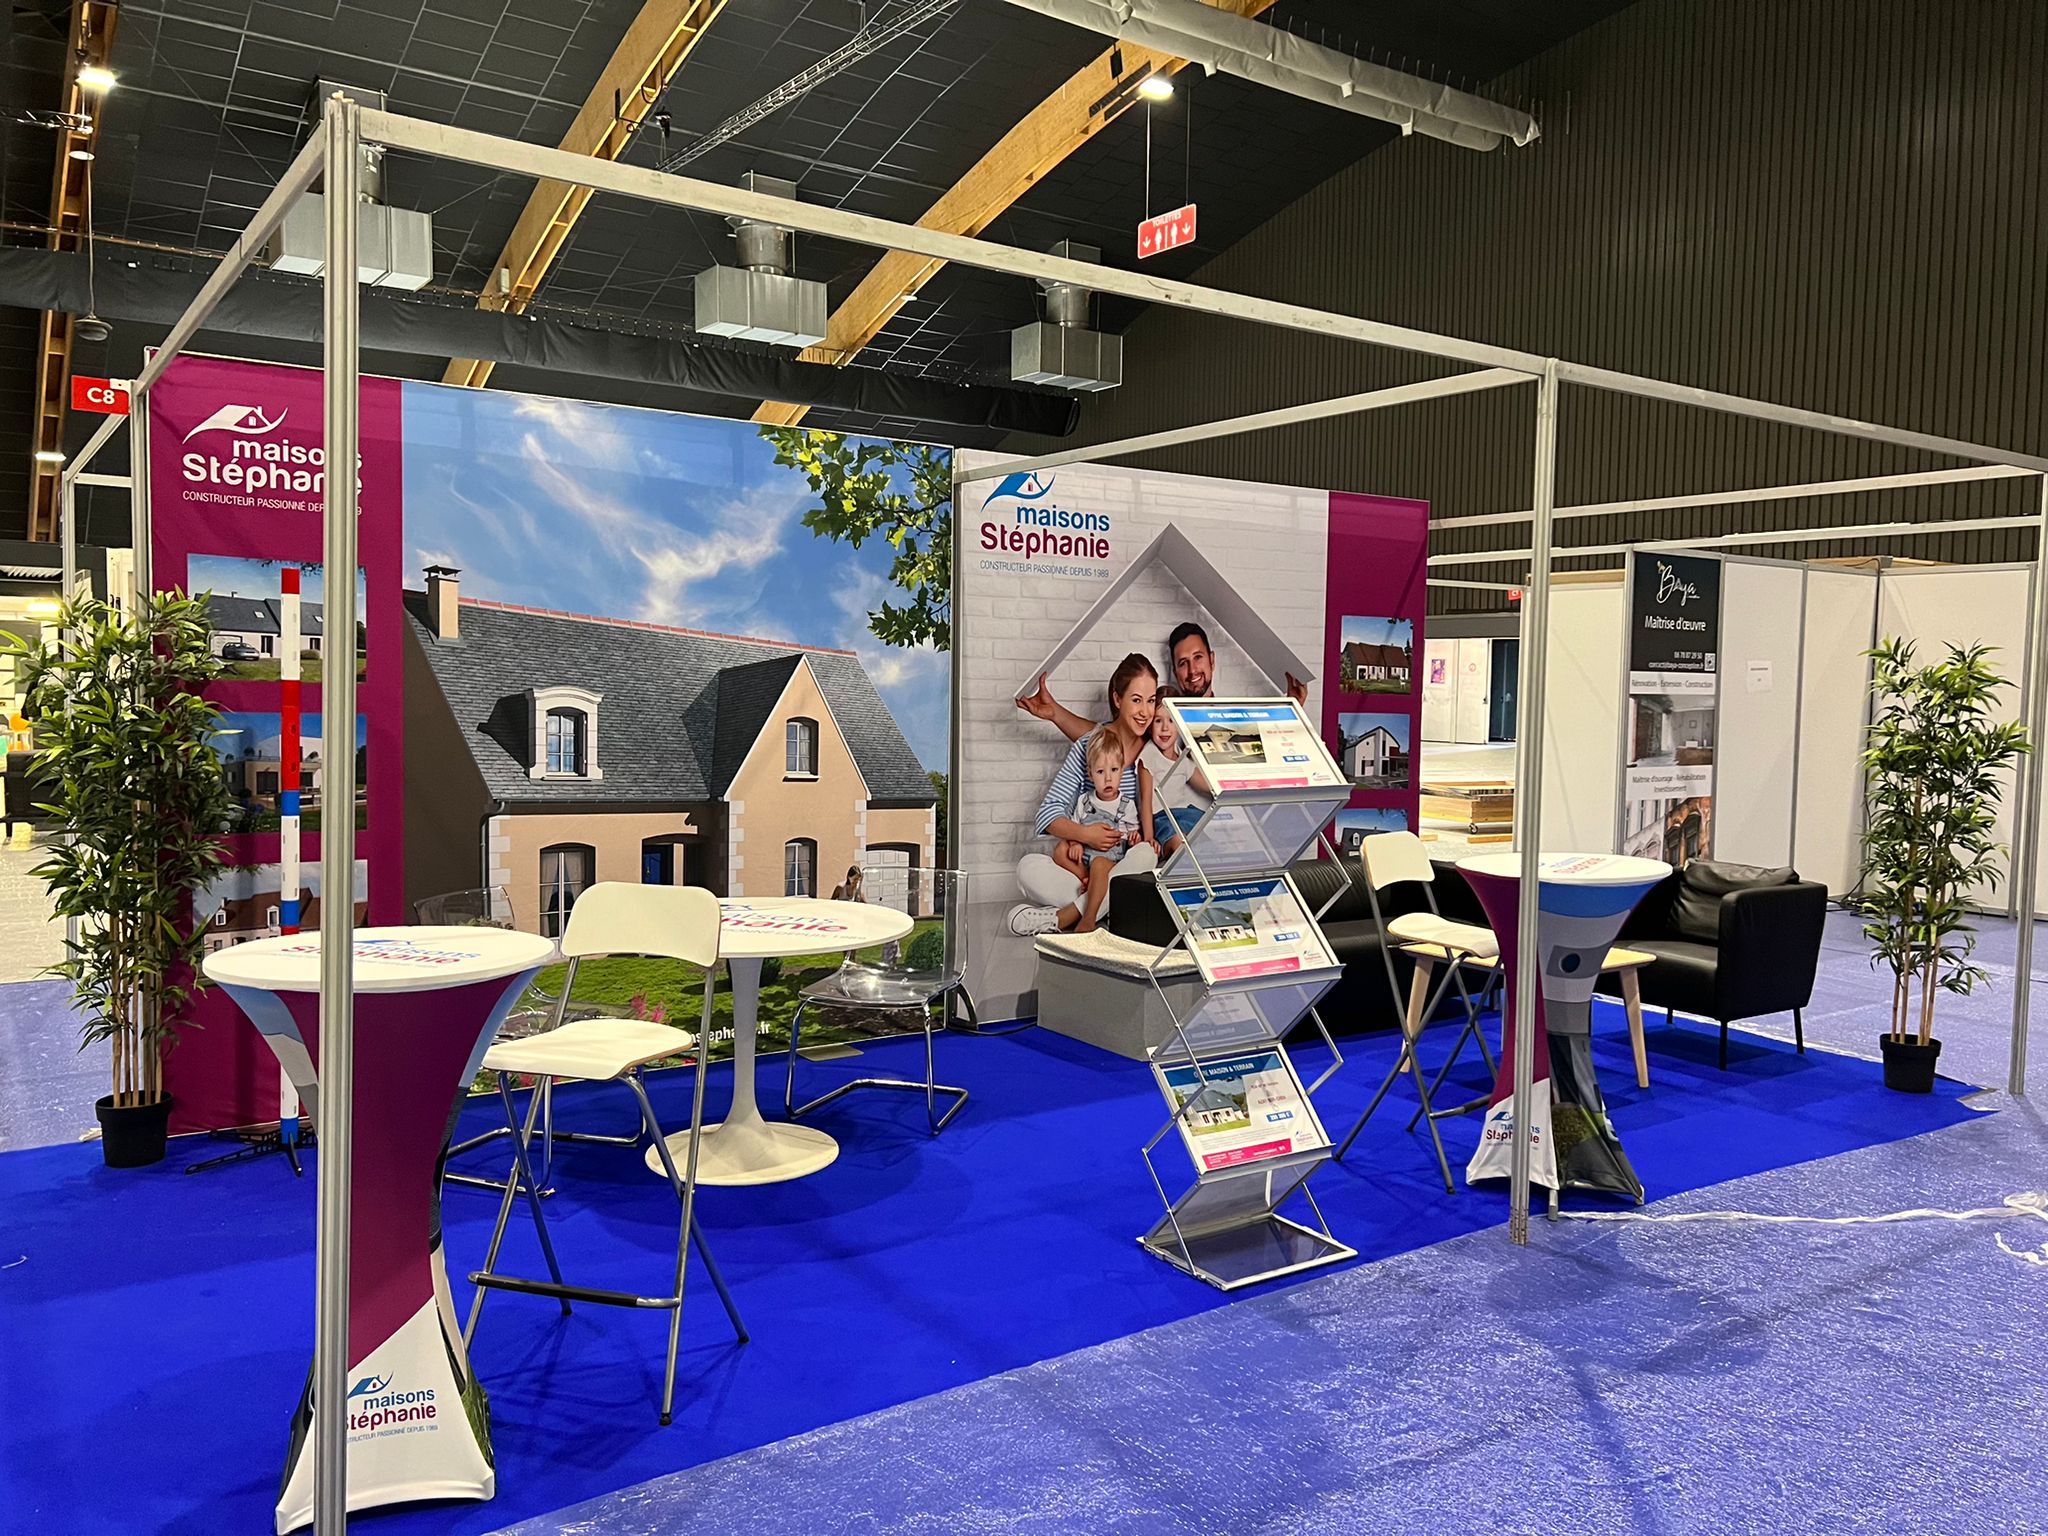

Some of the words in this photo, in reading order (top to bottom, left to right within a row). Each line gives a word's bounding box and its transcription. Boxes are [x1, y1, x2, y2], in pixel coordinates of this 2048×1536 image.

[87, 387, 115, 405] C8
[182, 490, 255, 506] CONSTRUCTEUR
[257, 497, 306, 511] PASSIONNÉ
[308, 502, 325, 512] DEP
[1017, 505, 1110, 532] maisons
[980, 522, 1110, 559] Stéphanie
[980, 559, 1032, 573] CONSTRUCTEUR
[1070, 566, 1092, 577] DEPUIS
[1093, 568, 1110, 578] 1989
[1645, 615, 1675, 630] Maîtrise
[1676, 616, 1706, 631] d'œuvre
[1233, 1062, 1255, 1072] TERRAIN
[364, 1389, 435, 1411] maisons
[407, 1425, 425, 1434] DEPUIS
